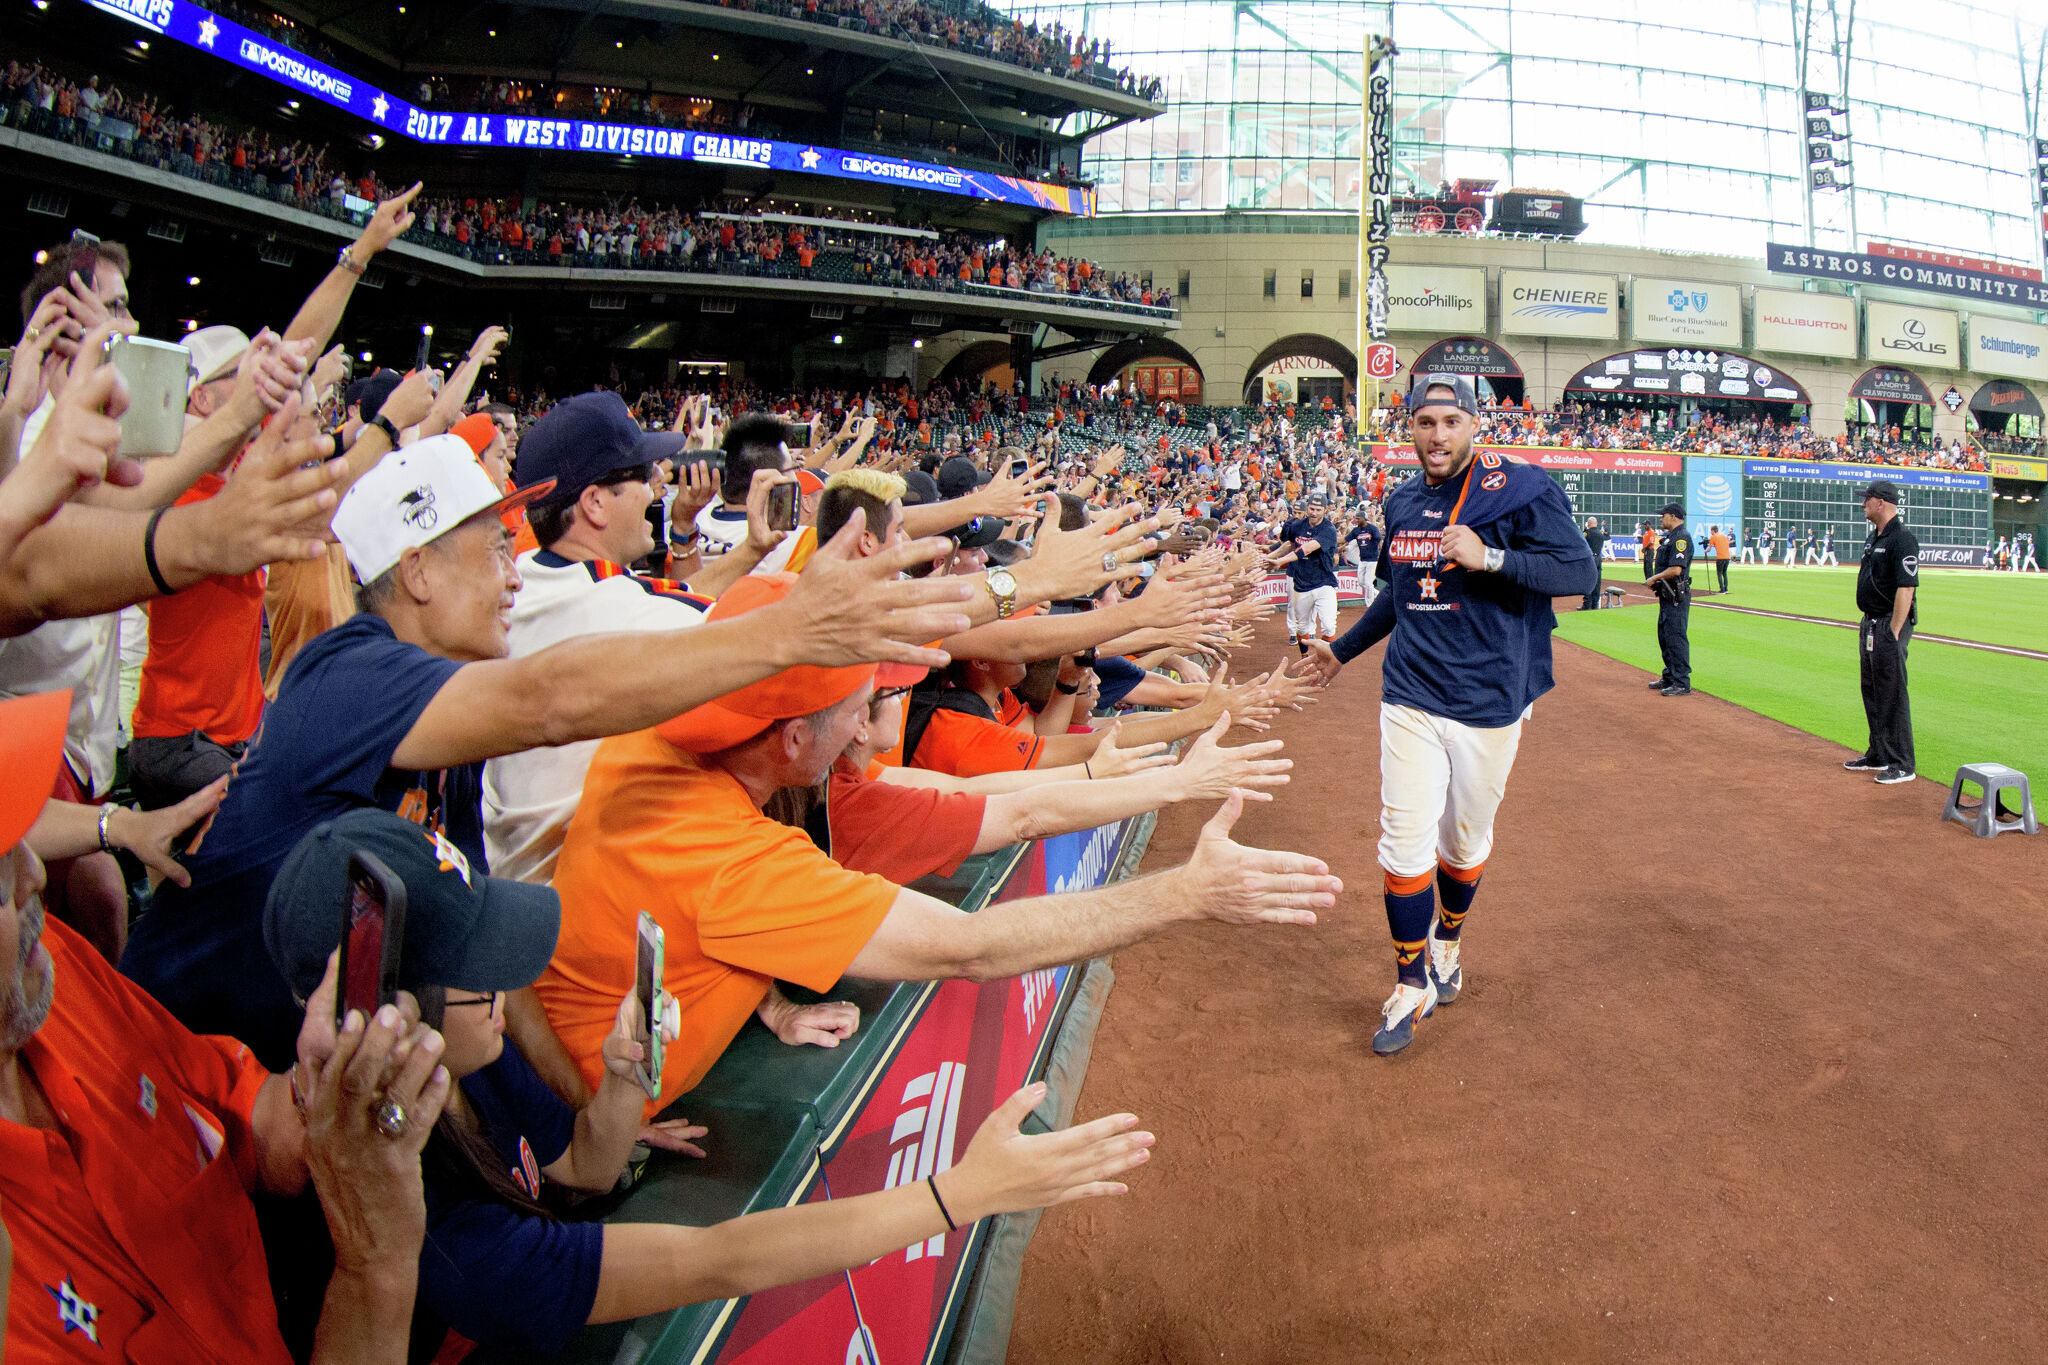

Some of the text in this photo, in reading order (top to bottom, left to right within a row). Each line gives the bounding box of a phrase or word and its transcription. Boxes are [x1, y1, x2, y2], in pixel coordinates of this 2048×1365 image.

[258, 47, 337, 96] POSTSEASON
[1811, 96, 1826, 107] 80
[1812, 121, 1828, 132] 86
[406, 108, 773, 163] 2017 AL WEST DIVISION CHAMPS
[1814, 147, 1829, 158] 97
[862, 161, 945, 185] POSTSEASON
[1815, 173, 1832, 184] 98
[1887, 247, 2029, 277] MINUTE MAID
[1883, 264, 2018, 298] COMMUNITY
[1512, 287, 1608, 305] CHENIERE
[1387, 294, 1473, 311] onocoPhillips
[1648, 314, 1728, 328] BlueCross BlueShield
[1763, 315, 1848, 331] HALLIBURTON
[1680, 327, 1705, 335] Texas
[1881, 337, 1947, 355] LEXUS
[1980, 335, 2041, 359] Schlumberger
[1443, 354, 1490, 362] LANDRY'S
[1268, 355, 1336, 374] ARNOL
[1427, 364, 1506, 374] CRAWFORD BOXES
[1862, 389, 1901, 399] CRAWFORD
[1902, 392, 1923, 401] BOXES
[1397, 450, 1419, 460] State
[1787, 467, 1820, 475] AIRLINES
[1563, 473, 1581, 482] NYM
[1919, 475, 1981, 486] UNITED AIRLINES
[1564, 483, 1579, 491] ATL
[1763, 481, 1778, 490] CWS
[1764, 490, 1776, 498] DET
[1765, 501, 1775, 509] KC
[1764, 510, 1776, 518] CLE
[1763, 520, 1777, 529] TOR
[1407, 530, 1426, 538] WEST
[1426, 530, 1445, 538] DIVI
[2016, 532, 2033, 542] 362
[1918, 549, 1974, 564] OTIRE.COM
[1411, 560, 1433, 568] TAKE
[1255, 581, 1288, 597] SMIRNO
[1338, 579, 1359, 591] RNOFF
[1413, 603, 1451, 611] POSTSEASON
